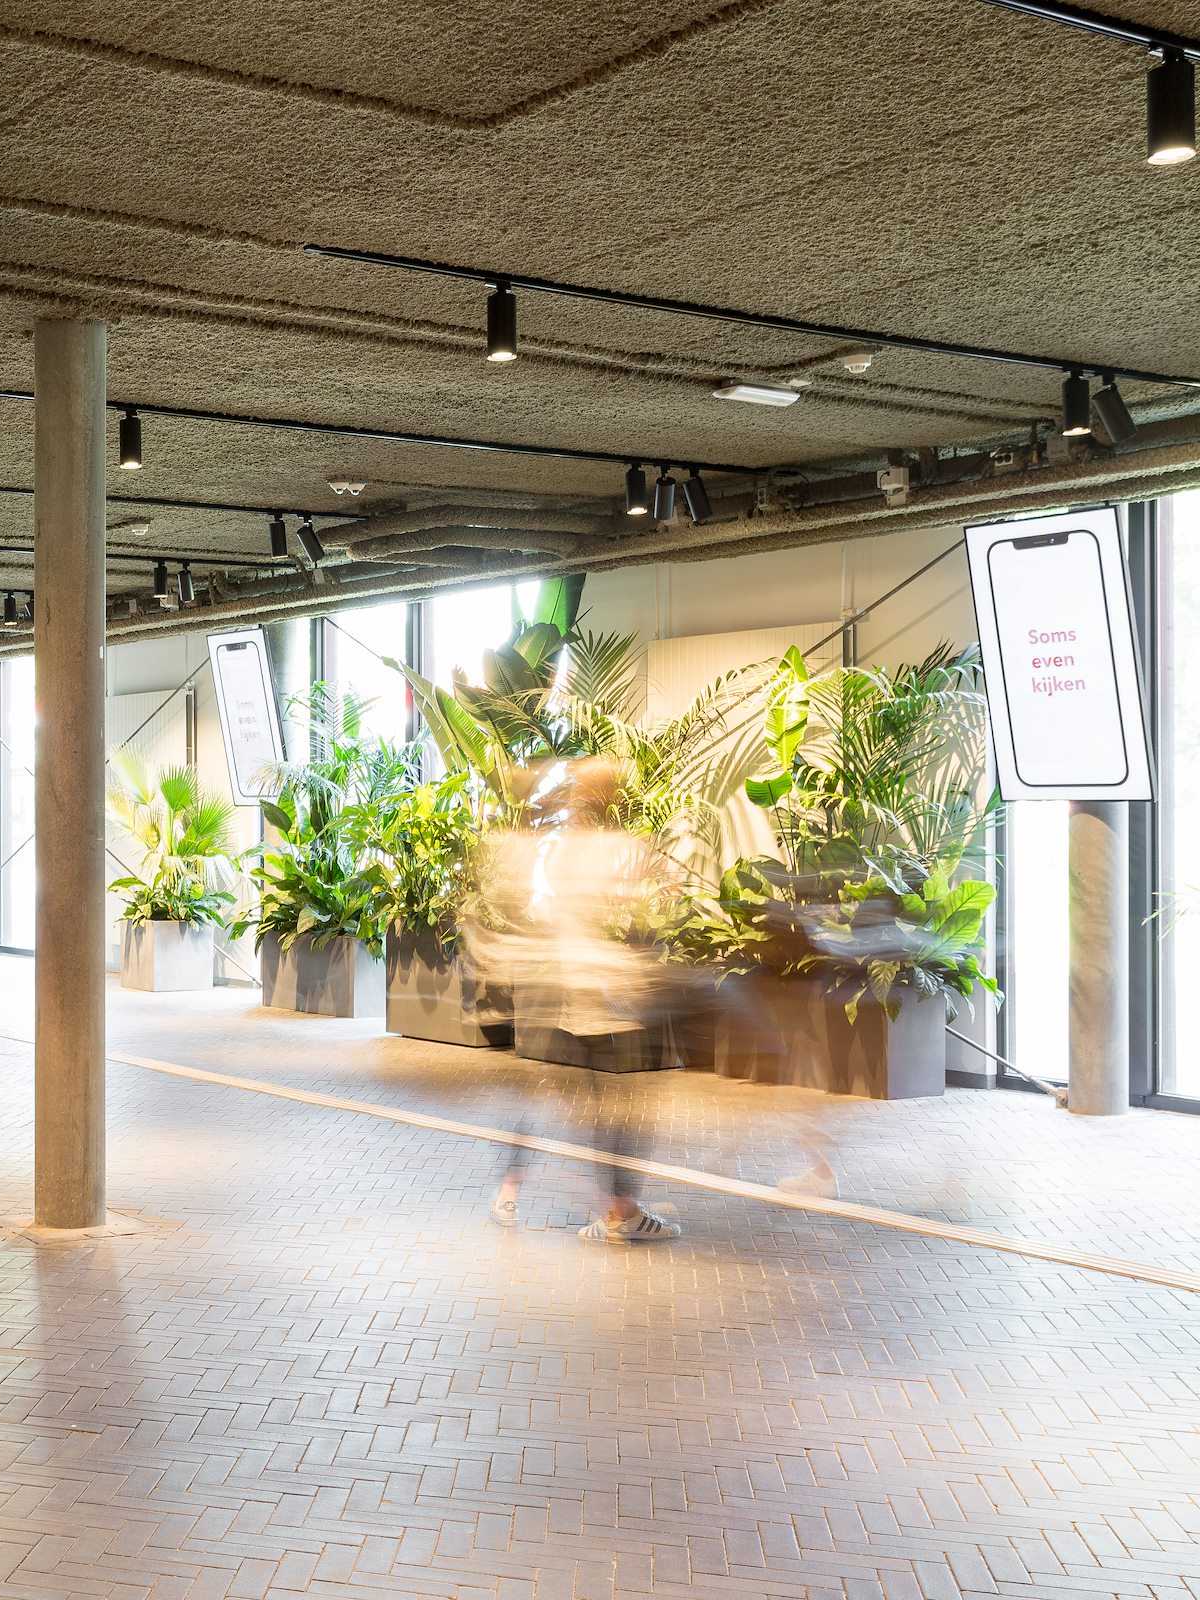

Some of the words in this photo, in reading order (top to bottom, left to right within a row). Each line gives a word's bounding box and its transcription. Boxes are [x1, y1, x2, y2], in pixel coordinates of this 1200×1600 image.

[1028, 629, 1077, 645] Soms
[1032, 655, 1075, 668] even
[1031, 676, 1086, 697] kijken
